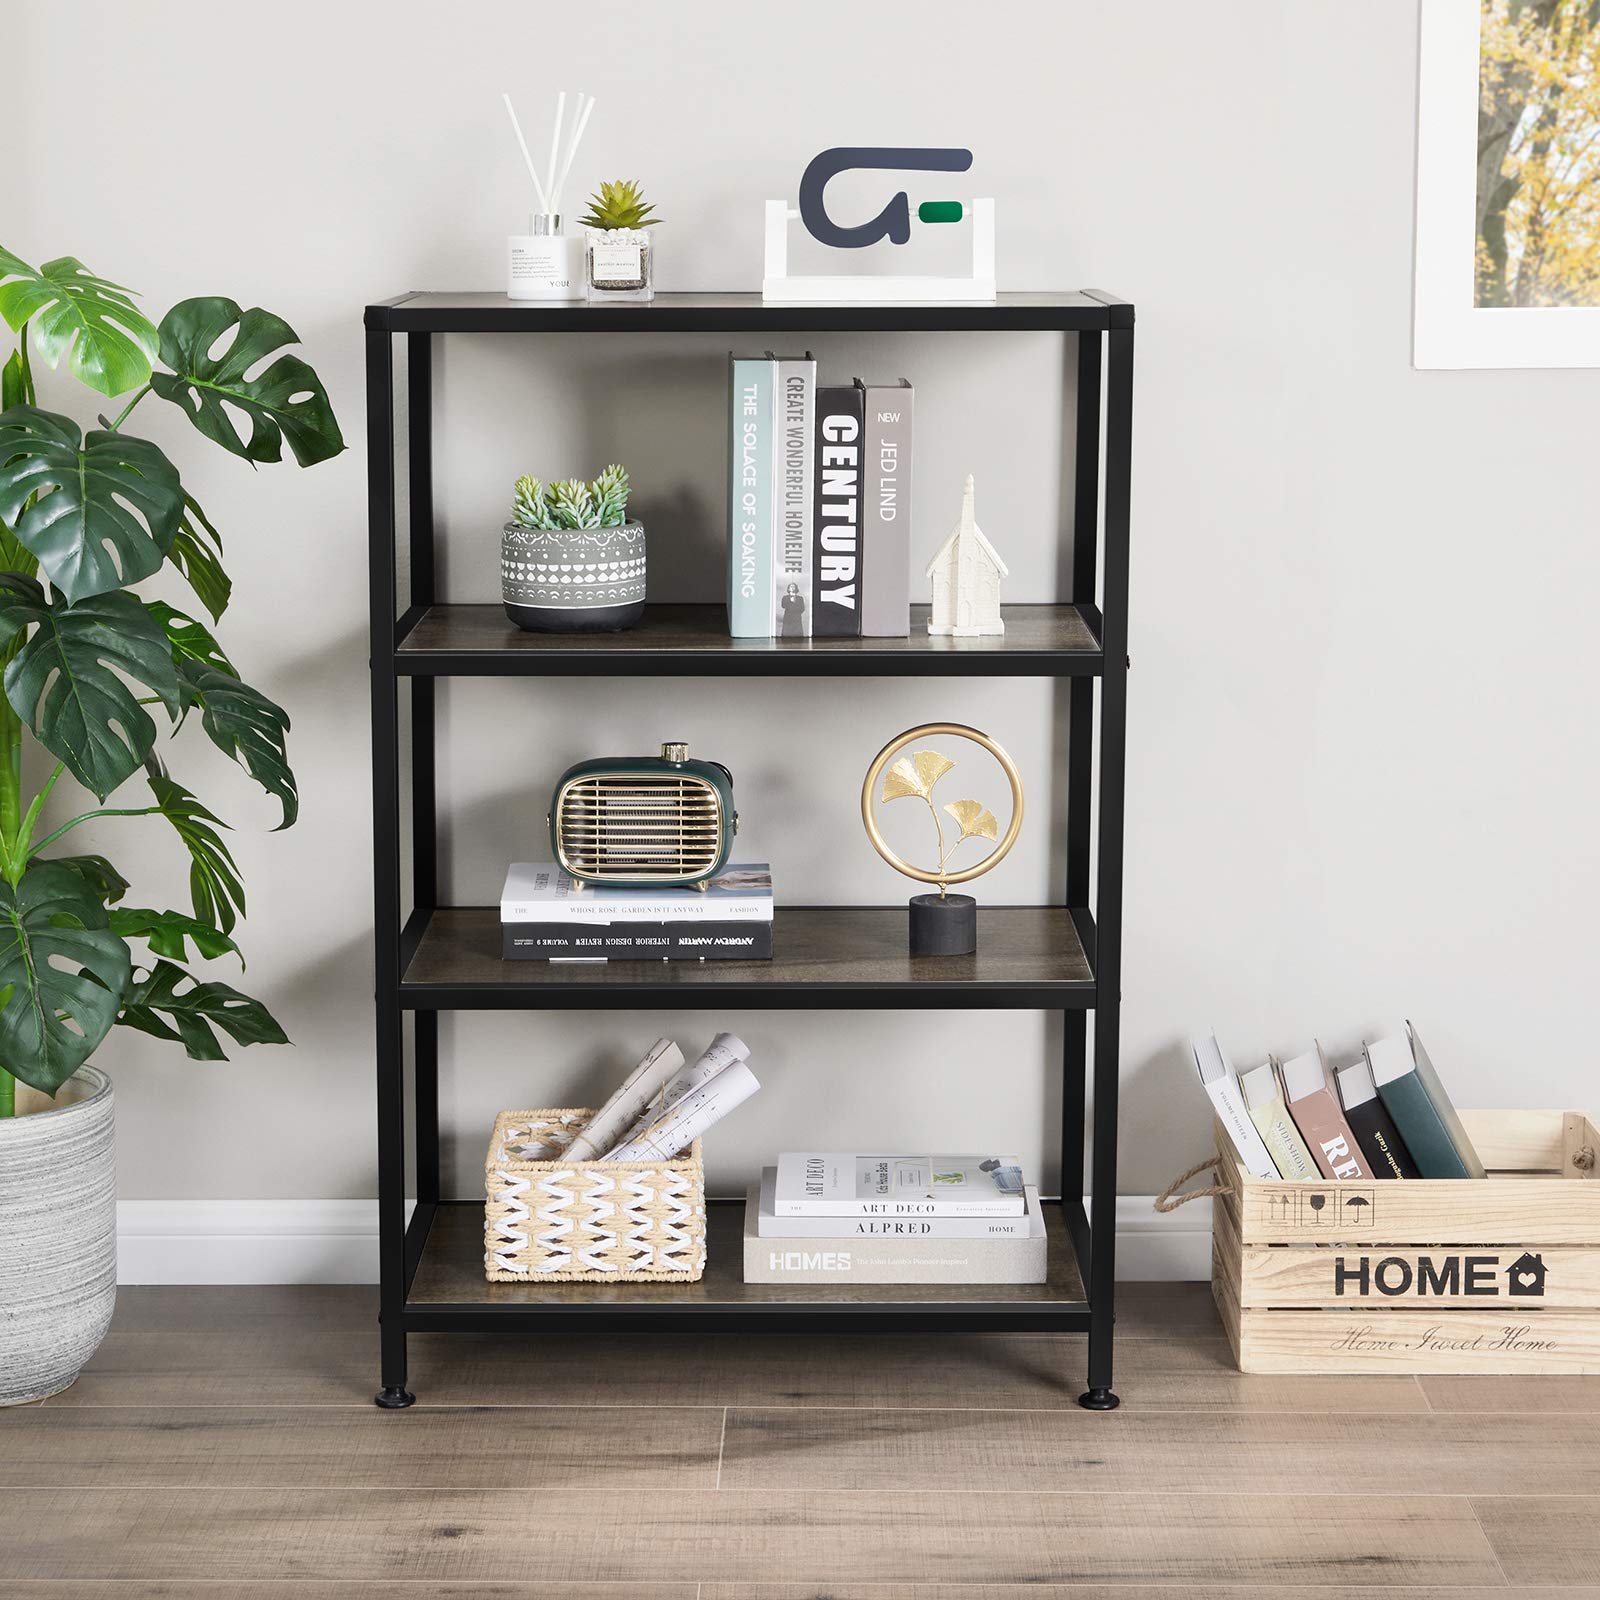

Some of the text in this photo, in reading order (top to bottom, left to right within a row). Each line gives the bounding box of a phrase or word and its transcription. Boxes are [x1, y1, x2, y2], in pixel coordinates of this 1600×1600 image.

[877, 413, 901, 424] NEW
[785, 376, 805, 574] CREATE WONDERFUL HOMELIFE
[880, 438, 898, 523] JED LIND
[741, 384, 758, 598] THE SOLACE OF SOAKING
[820, 414, 860, 611] CENTURY
[542, 938, 569, 946] VOLUME
[575, 937, 670, 946] INTERIOR DESIGN REVIEW
[679, 937, 754, 945] ANDREW MARTIN
[1219, 1091, 1235, 1115] VOLUME
[1276, 1121, 1308, 1173] SIDESHOW
[805, 1158, 825, 1197] ART DECO
[860, 1204, 936, 1214] ART DECO
[855, 1222, 932, 1234] ALPRED
[988, 1225, 1016, 1234] HOME
[769, 1252, 852, 1271] HOMES
[1335, 1256, 1500, 1296] HOME
[1331, 1325, 1558, 1352] Home Sweet Home
